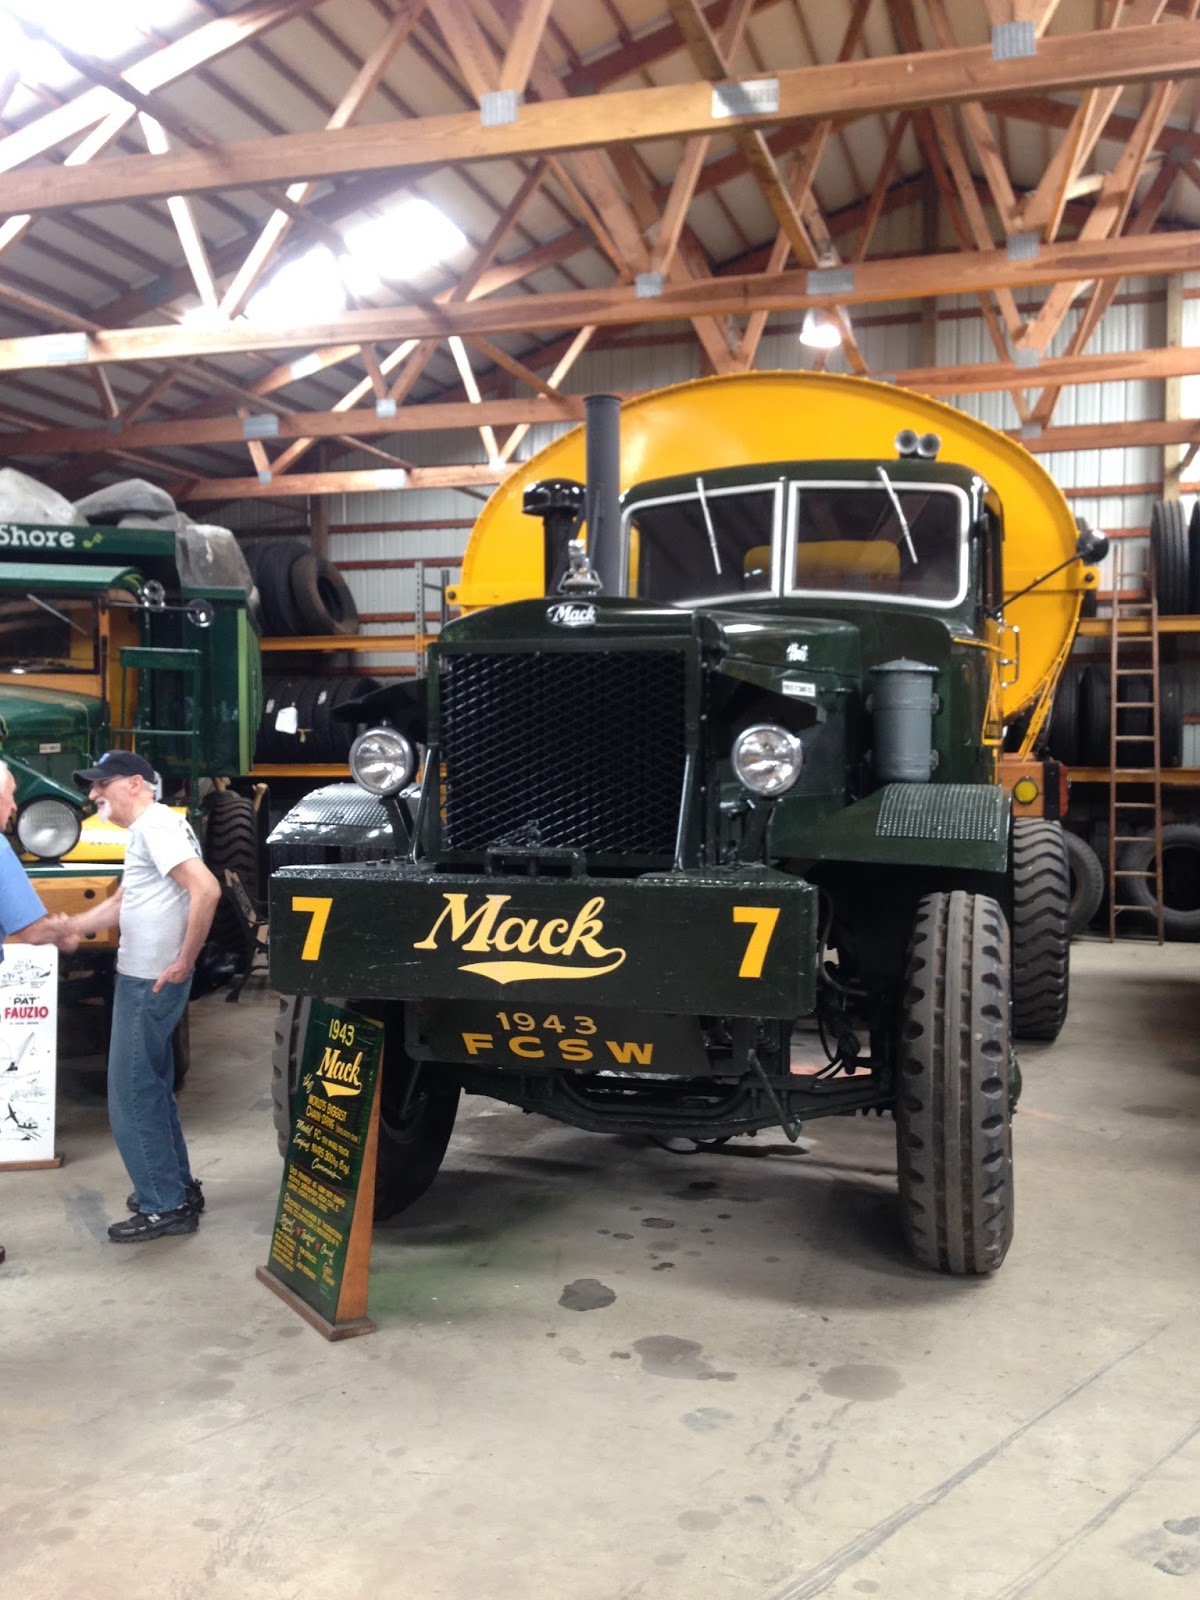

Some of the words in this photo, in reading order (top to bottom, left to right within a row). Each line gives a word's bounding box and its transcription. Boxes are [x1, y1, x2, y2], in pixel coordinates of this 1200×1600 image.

[0, 525, 75, 548] Shore
[552, 605, 596, 626] Mack
[292, 896, 333, 961] 7
[413, 893, 626, 984] Mack
[733, 906, 781, 978] 7
[4, 1006, 49, 1019] FAUZIO
[496, 1011, 598, 1036] 1943
[329, 1018, 355, 1046] 1943
[461, 1032, 654, 1066] FCSW
[316, 1046, 363, 1097] Mack
[327, 1103, 347, 1122] BIGGEST
